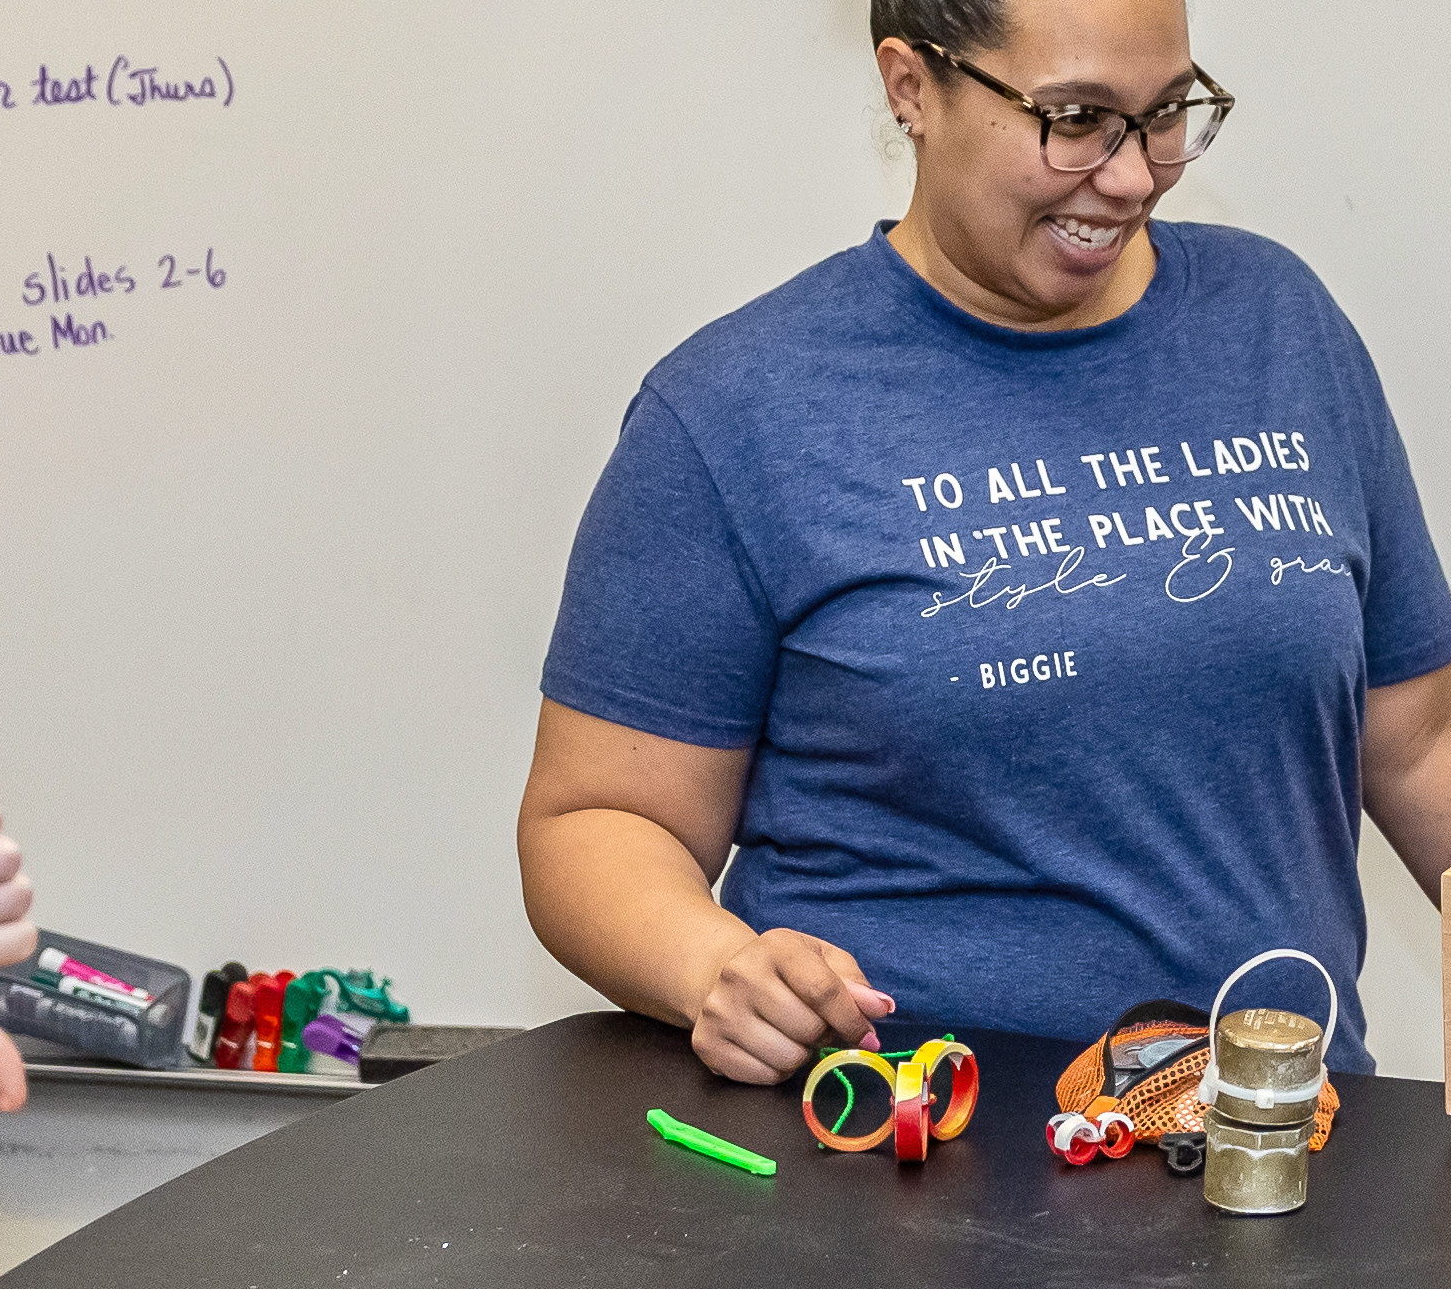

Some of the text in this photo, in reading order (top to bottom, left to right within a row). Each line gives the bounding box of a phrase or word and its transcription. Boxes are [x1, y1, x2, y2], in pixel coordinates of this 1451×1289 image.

[34, 65, 111, 105] test
[22, 252, 137, 307] slides
[156, 247, 226, 290] 2-6
[902, 431, 1310, 512] TO ALL THE LADIES
[919, 493, 1334, 568] IN THE PLACE WITH
[920, 546, 1127, 618] style
[980, 652, 1078, 689] BIGGIE
